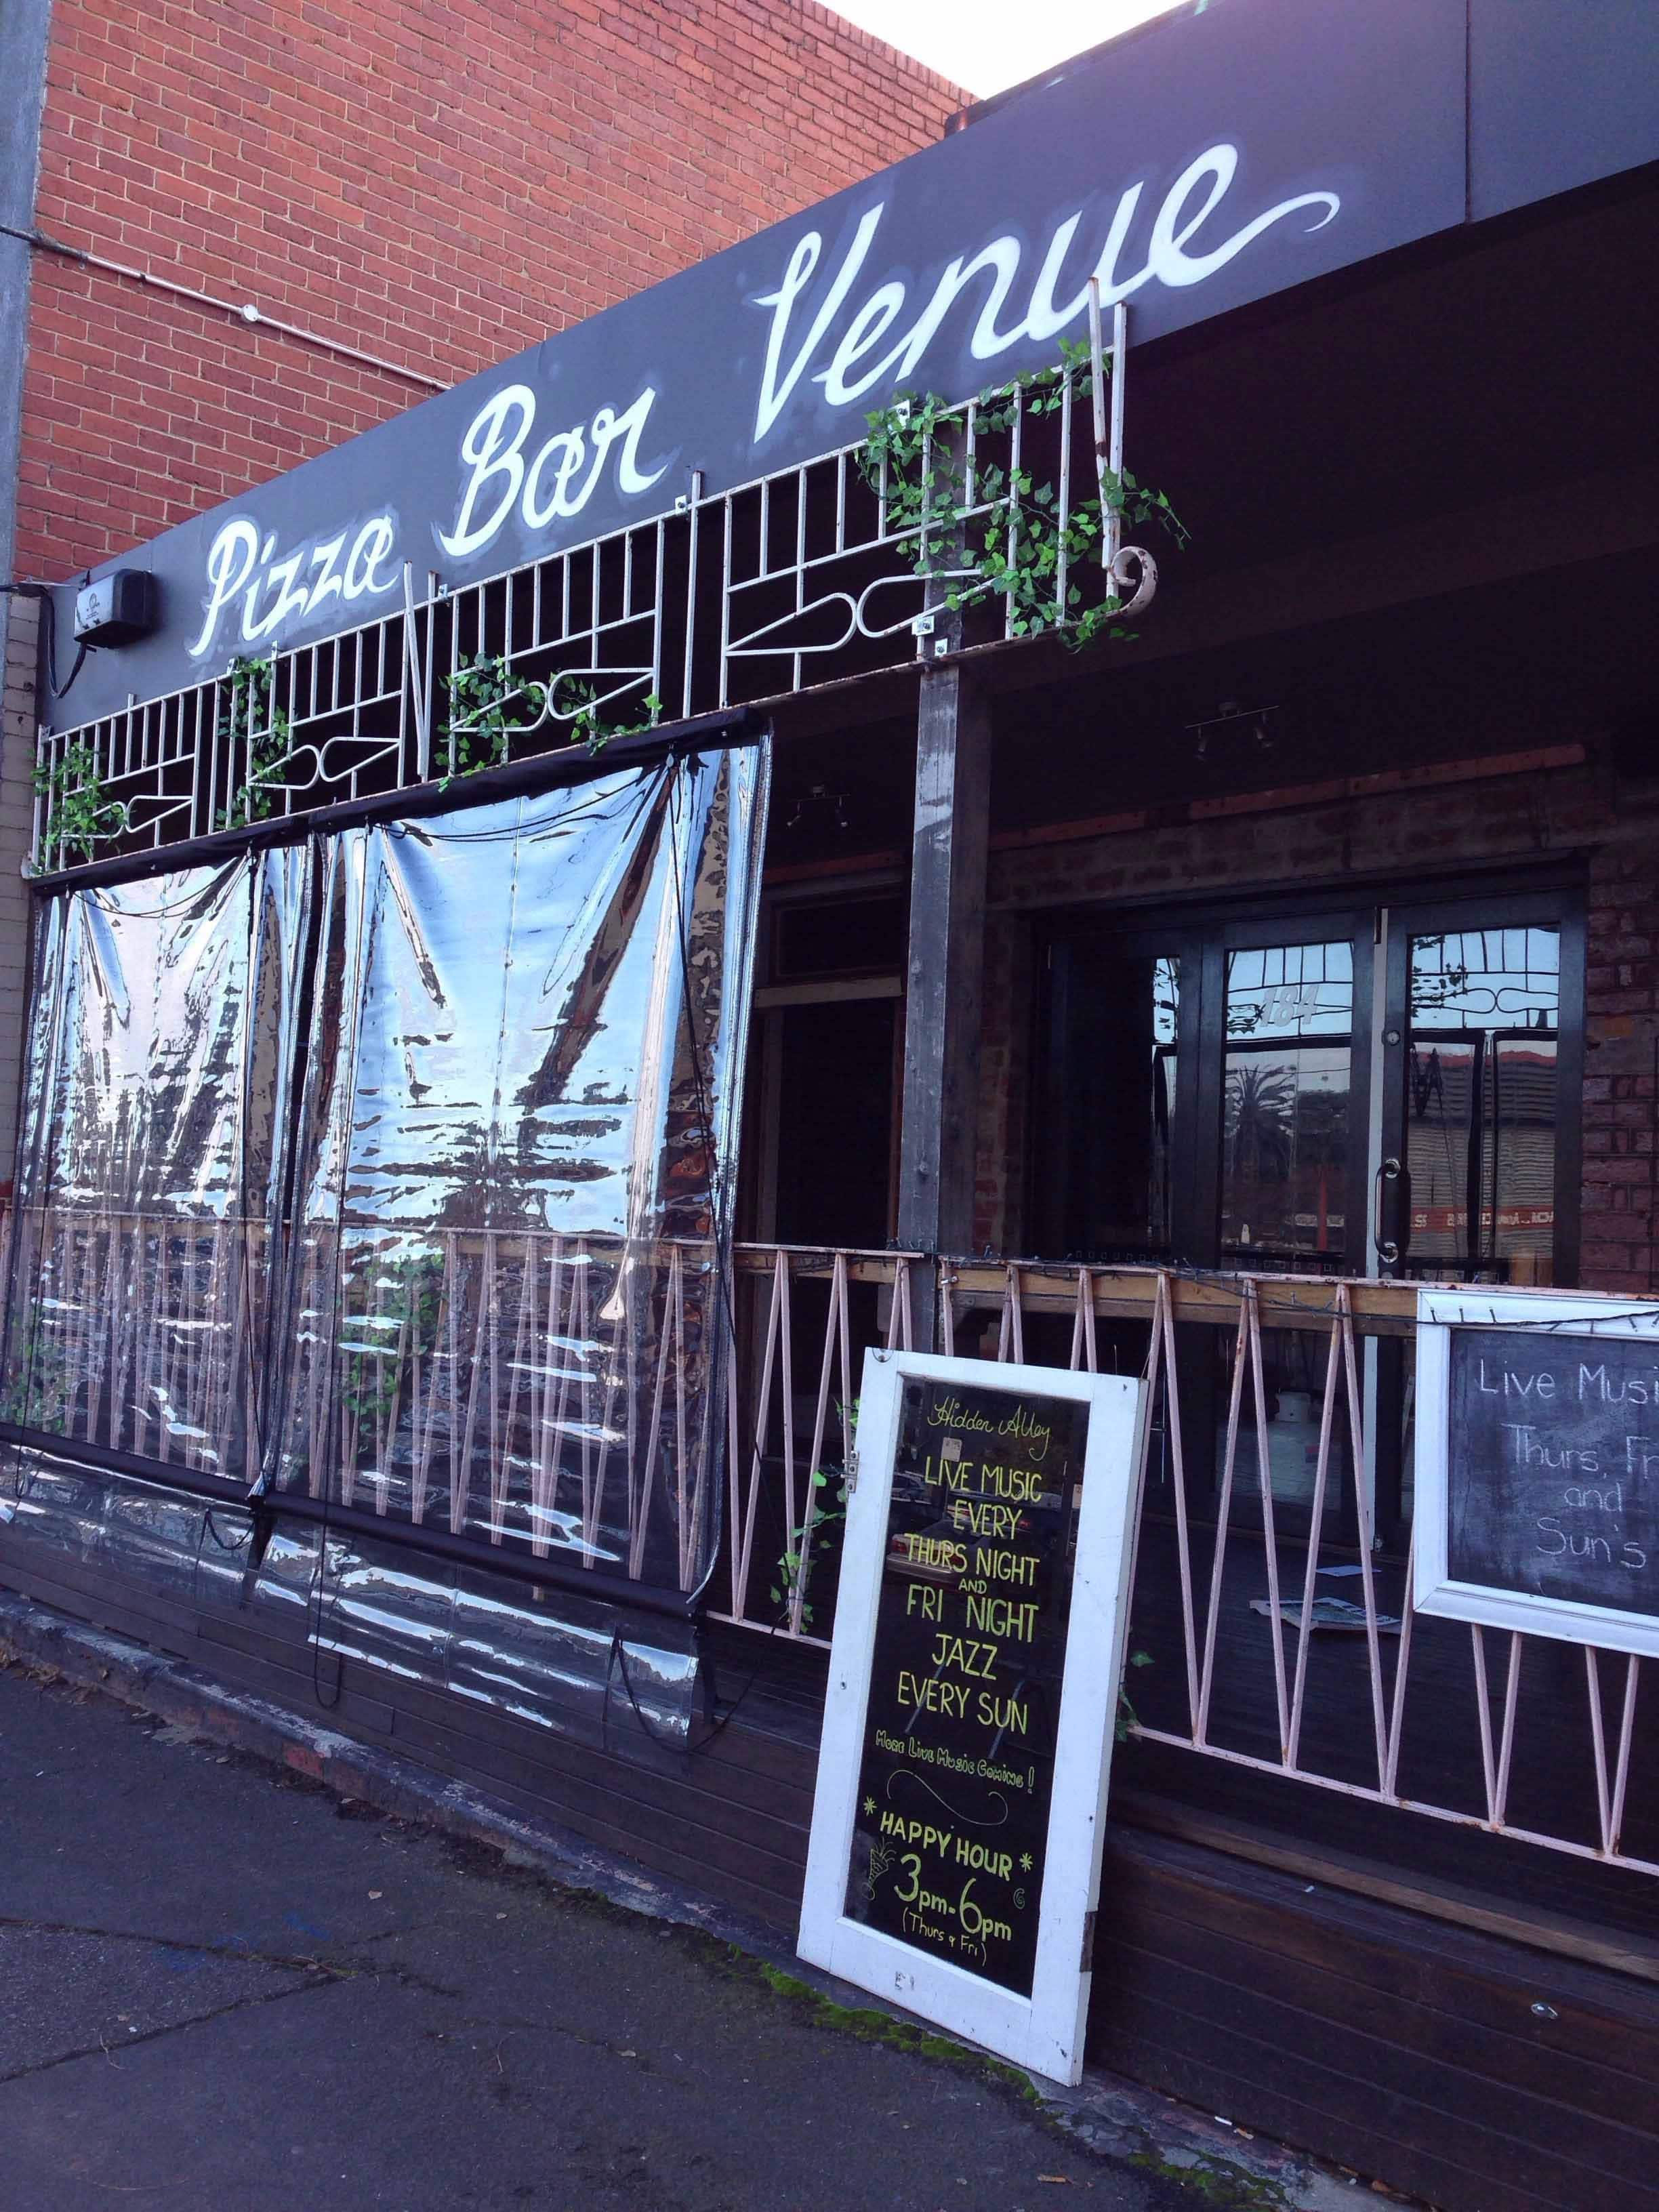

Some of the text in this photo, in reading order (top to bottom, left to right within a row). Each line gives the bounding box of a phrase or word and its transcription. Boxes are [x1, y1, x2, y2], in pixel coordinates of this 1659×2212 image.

[187, 143, 1340, 657] Pizza Bar Venue
[1260, 985, 1319, 1027] 184
[1480, 1358, 1659, 1406] Live Musi
[927, 1395, 1050, 1461] Hidden Alley
[924, 1456, 1042, 1502] LIVE MUSIC
[1626, 1435, 1659, 1480] Fr
[954, 1499, 1023, 1540] EVERY
[1563, 1483, 1622, 1512] and
[904, 1533, 1040, 1586] THURS NIGHT
[1536, 1517, 1646, 1569] Sun's
[958, 1577, 987, 1595] AND
[907, 1584, 1040, 1643] FRI NIGHT
[932, 1633, 998, 1680] JAZZ
[898, 1671, 1028, 1735] EVERY SUN
[880, 1811, 1012, 1881] HAPPY HOUR
